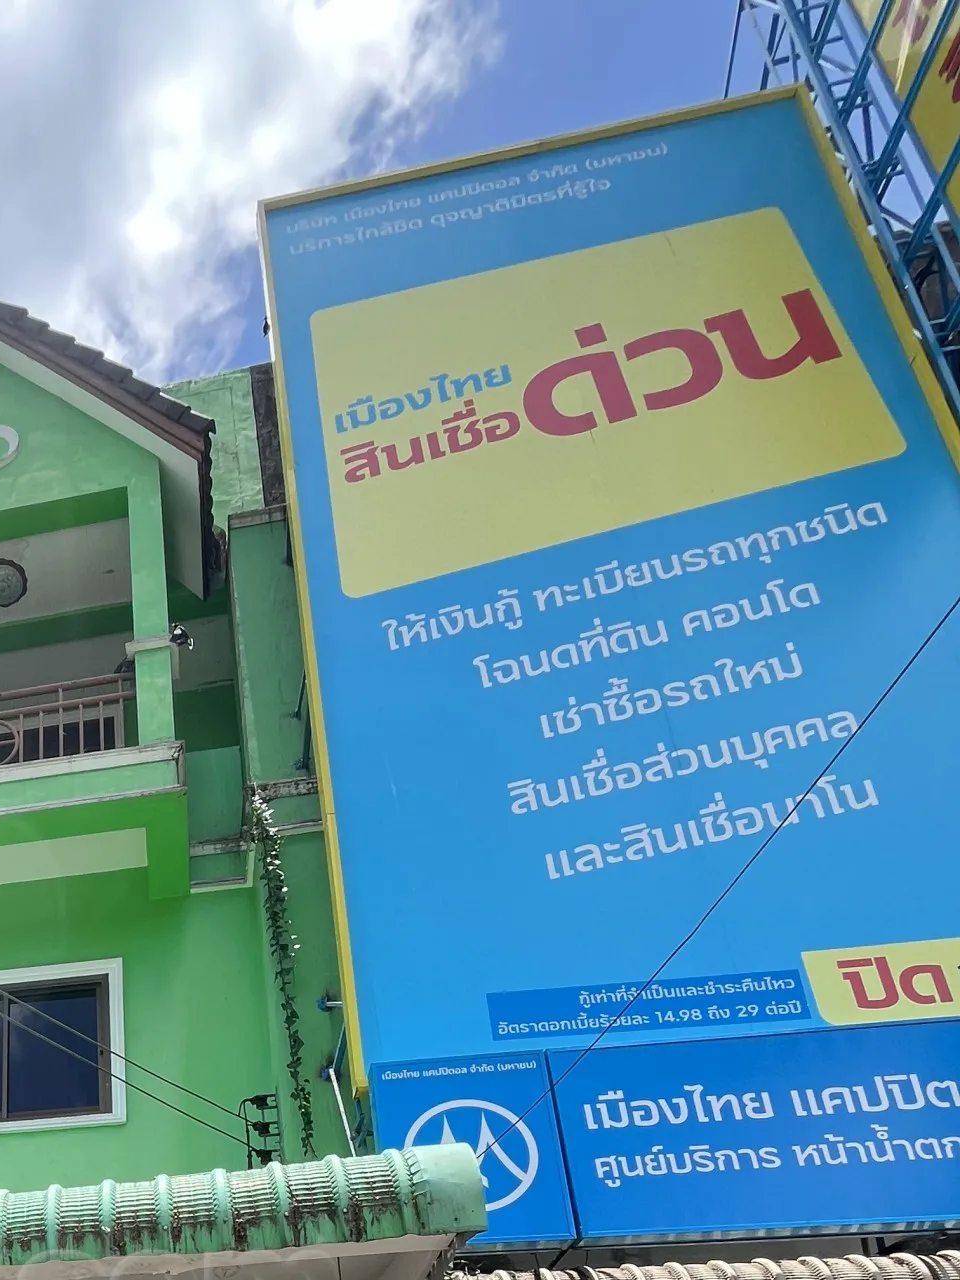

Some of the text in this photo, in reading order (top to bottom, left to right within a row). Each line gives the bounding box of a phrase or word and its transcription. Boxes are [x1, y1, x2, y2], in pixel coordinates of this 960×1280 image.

[344, 196, 421, 222] เมืองไทย
[527, 162, 578, 183] จำกัด
[585, 142, 668, 171] (มหาชน)
[334, 363, 513, 434] เมืองไทย
[340, 288, 843, 484] สินเชื่อ ด่วน
[382, 500, 888, 651] ให้เงินกู้ ทะเบียนรถทุกชนิด
[473, 578, 821, 689] โฉนดที่ดิน คอนโด
[540, 642, 804, 739] เช่าซื้อรถใหม่
[508, 707, 858, 815] สินเชื่อส่วนบุคคล
[545, 774, 879, 881] และสินเชื่อนาโน
[497, 999, 803, 1036] อัตราดอกเบี้ยร้อยละ 14.98 ถึง 29 ต่อปี
[578, 976, 796, 1009] กู้เท่าที่จำเป็นและชำระคืนไหว
[836, 955, 954, 1010] ปิด
[382, 1060, 537, 1081] เมืองไทย แคปปิตอล จำกัด (มหาชน)
[583, 1084, 775, 1130] เมืองไทย
[594, 1123, 960, 1188] ศูนย์บริการ หน้าน้ำตก
